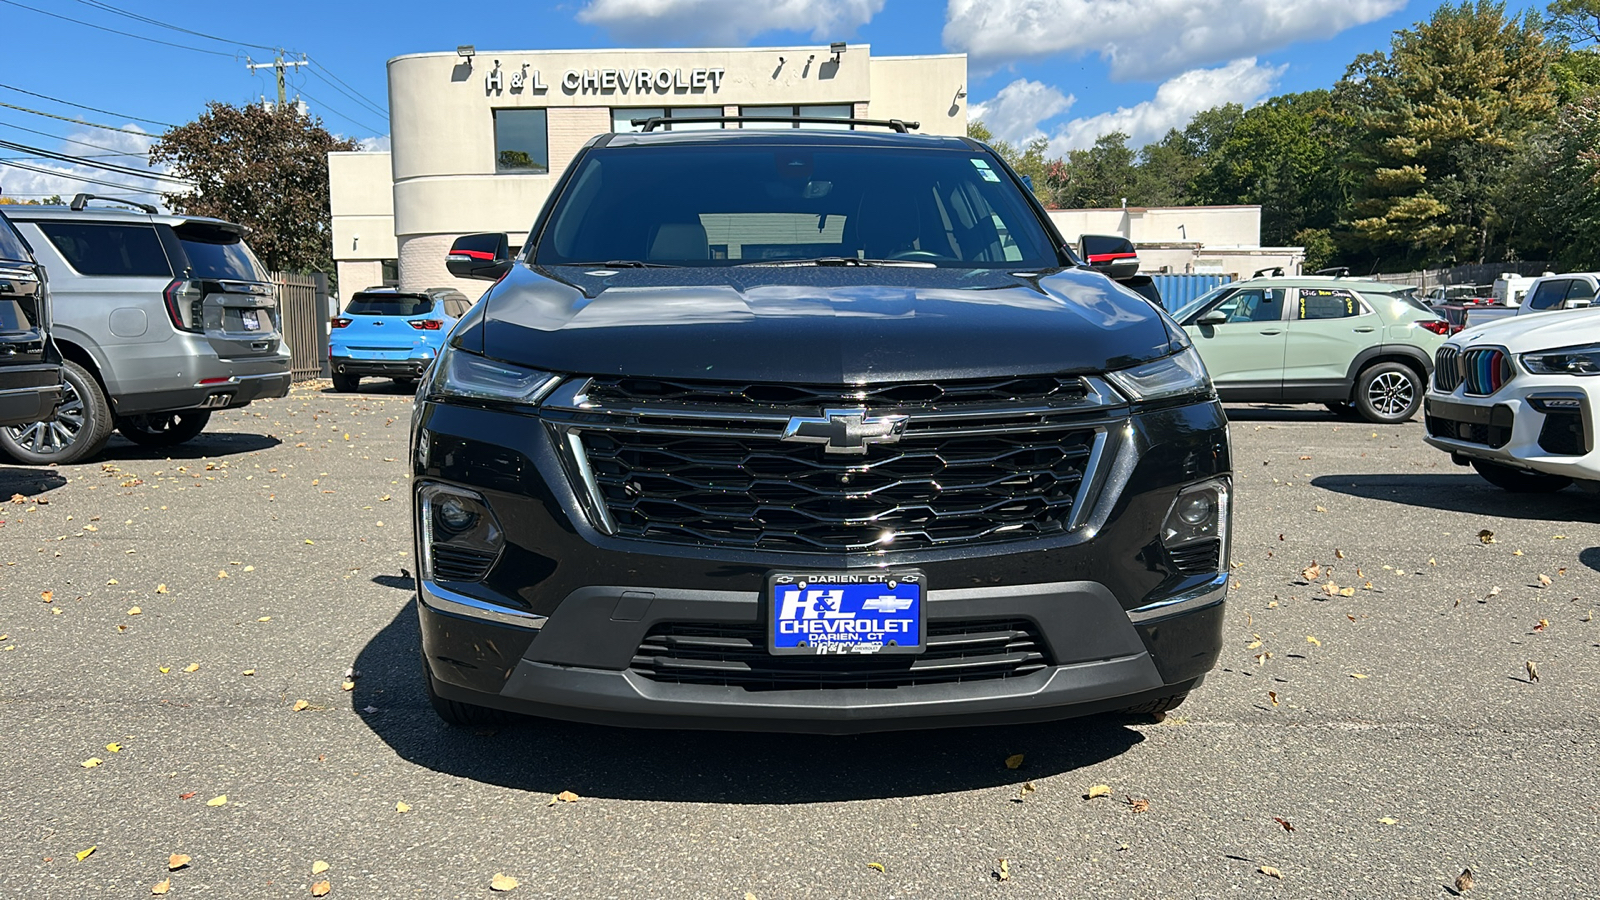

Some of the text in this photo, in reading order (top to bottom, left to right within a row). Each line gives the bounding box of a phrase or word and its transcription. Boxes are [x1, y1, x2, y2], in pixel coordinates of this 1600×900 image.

[486, 68, 725, 90] H & L CHEVROLET
[808, 575, 888, 583] DARIEN, CT.
[780, 590, 856, 619] H&L
[780, 620, 913, 633] CHEVROLET
[808, 632, 885, 641] DARIEN, CT
